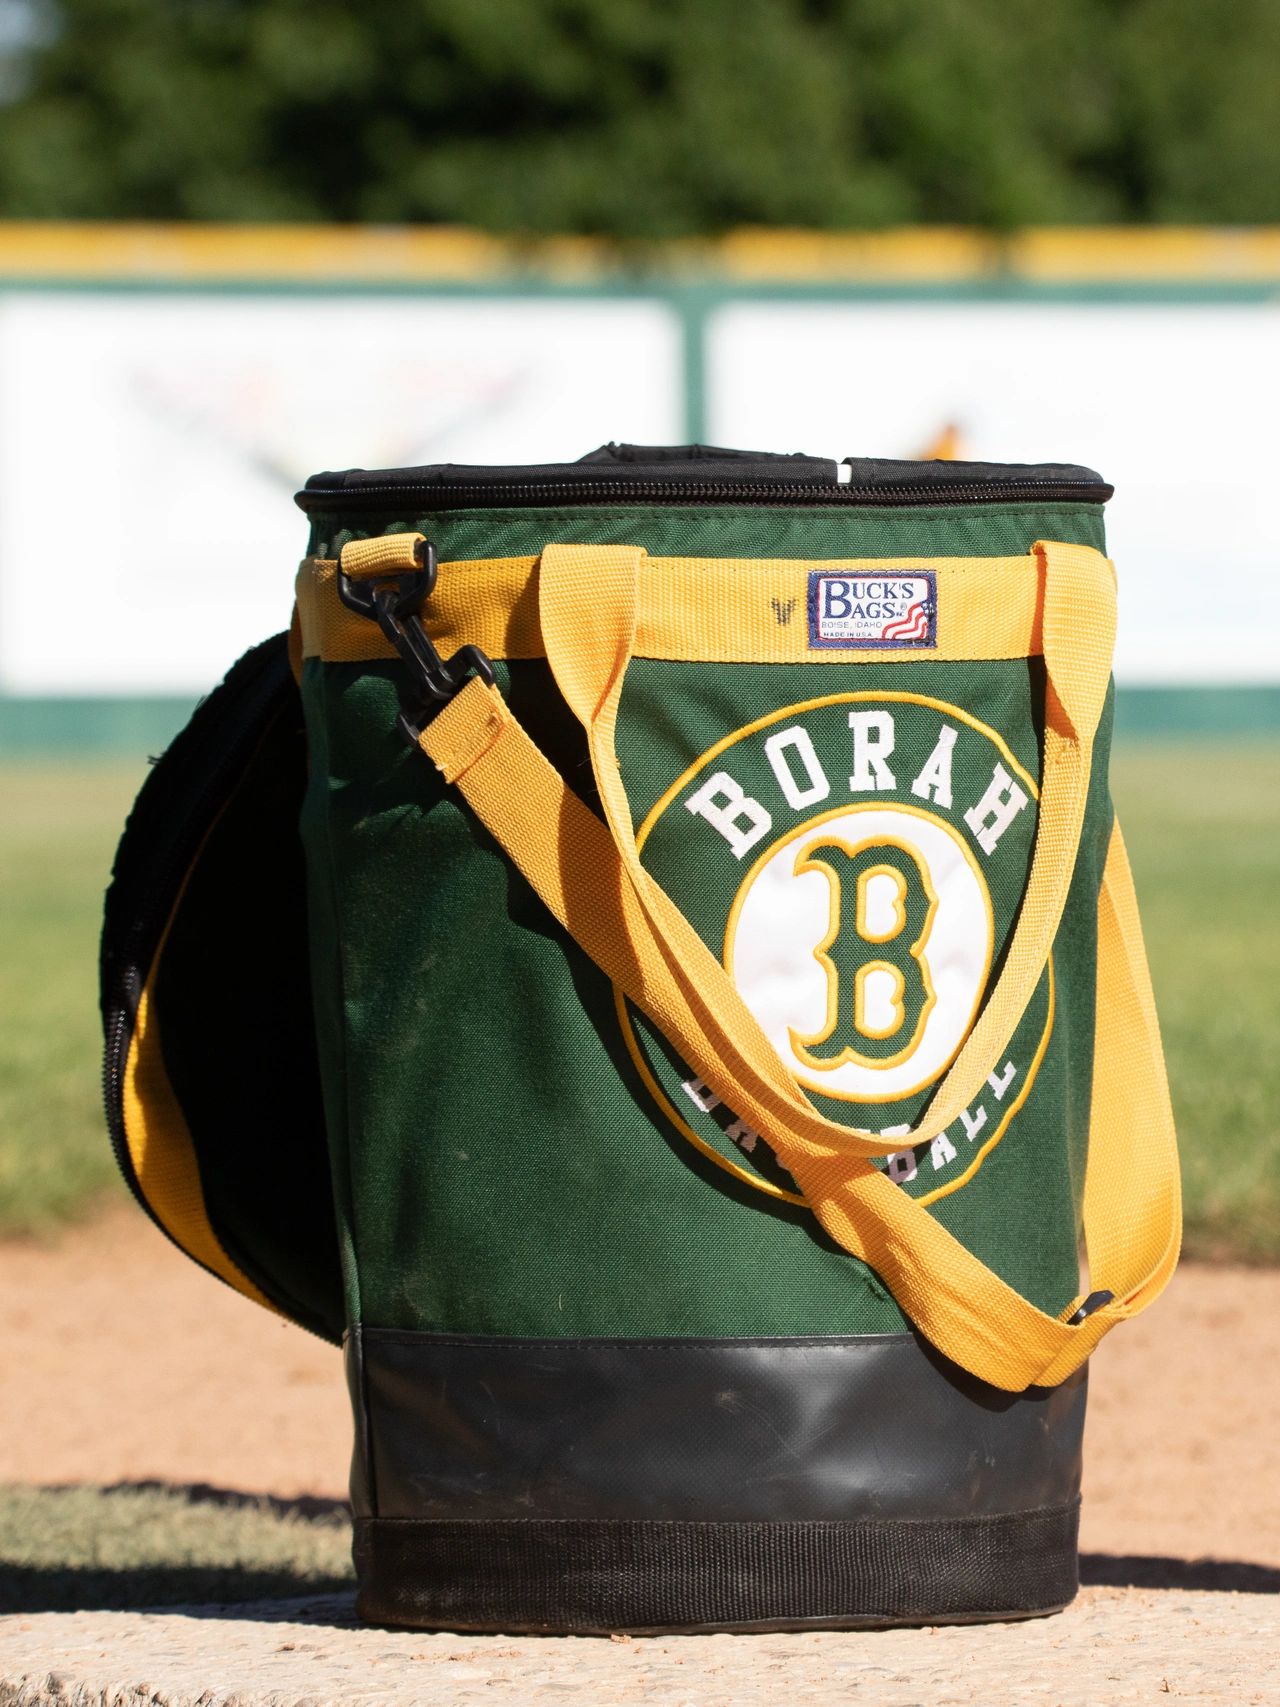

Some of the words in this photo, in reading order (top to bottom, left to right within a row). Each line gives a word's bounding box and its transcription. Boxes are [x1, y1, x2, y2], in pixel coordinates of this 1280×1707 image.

[823, 580, 914, 604] BUCK'S
[684, 711, 1029, 860] BORAH
[789, 835, 938, 1071] B
[681, 1061, 1017, 1184] ABALL
